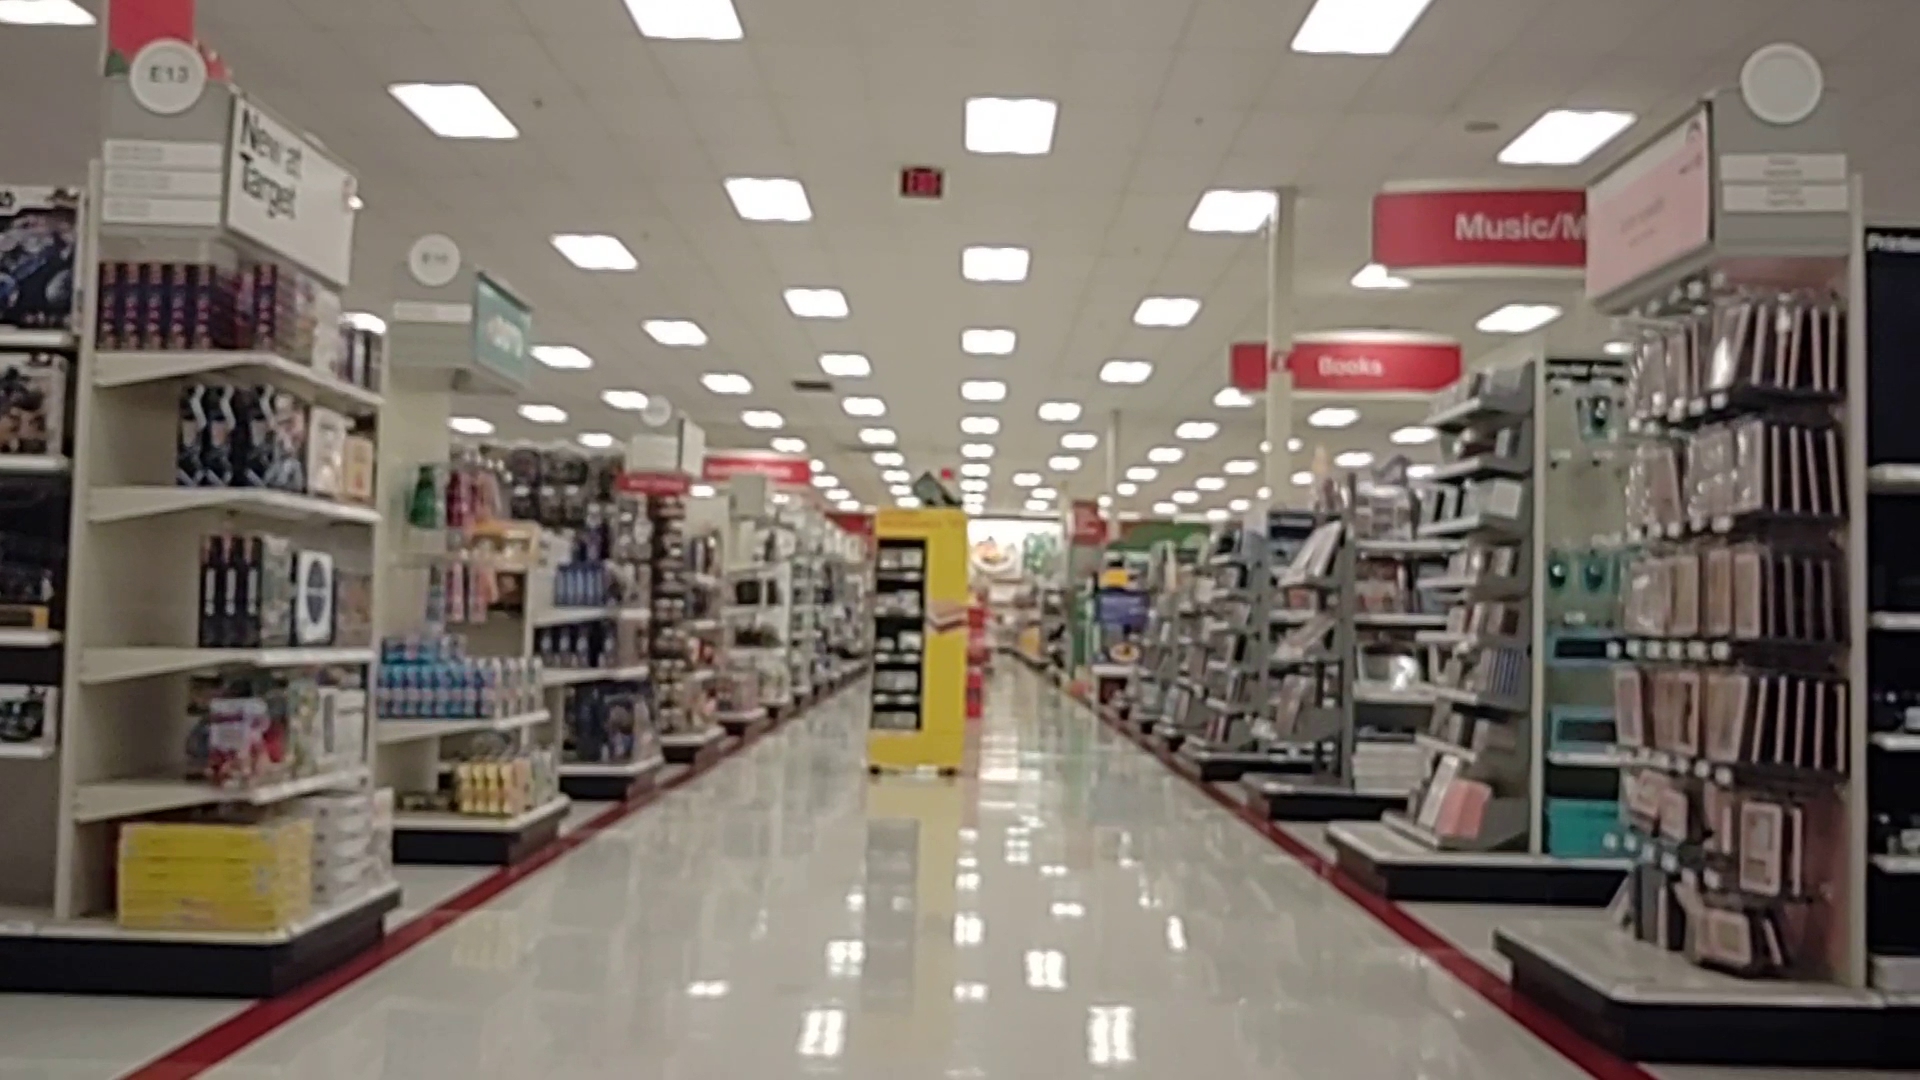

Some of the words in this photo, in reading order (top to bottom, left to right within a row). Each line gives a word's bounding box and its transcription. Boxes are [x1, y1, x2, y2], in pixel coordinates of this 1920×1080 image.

[150, 66, 190, 83] E13
[241, 108, 280, 164] New
[285, 148, 302, 178] at
[240, 151, 296, 220] Target
[1318, 355, 1383, 377] Books
